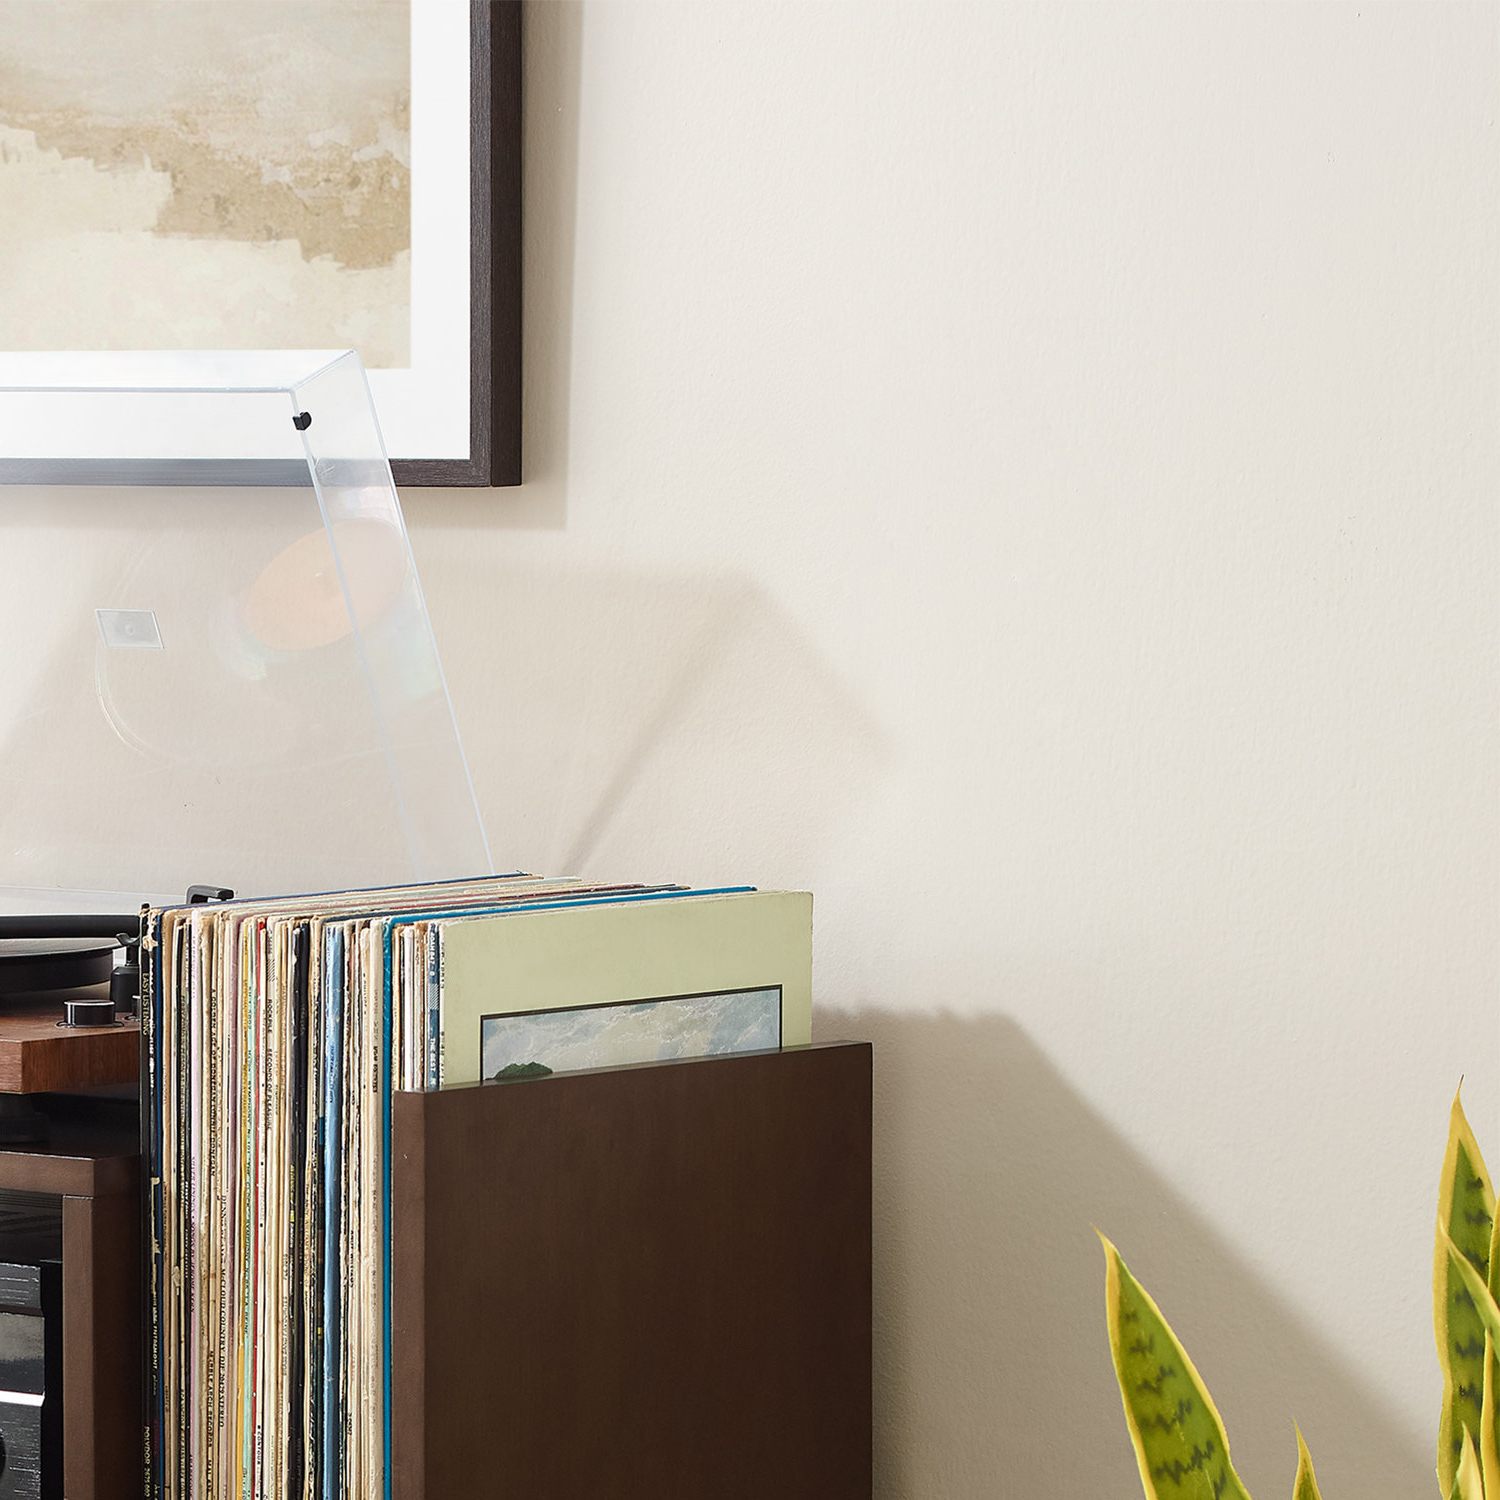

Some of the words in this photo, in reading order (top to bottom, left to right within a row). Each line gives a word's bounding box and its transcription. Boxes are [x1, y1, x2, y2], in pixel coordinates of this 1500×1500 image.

[142, 972, 150, 994] EASY
[142, 994, 150, 1036] LISTENING
[266, 1083, 273, 1094] OF
